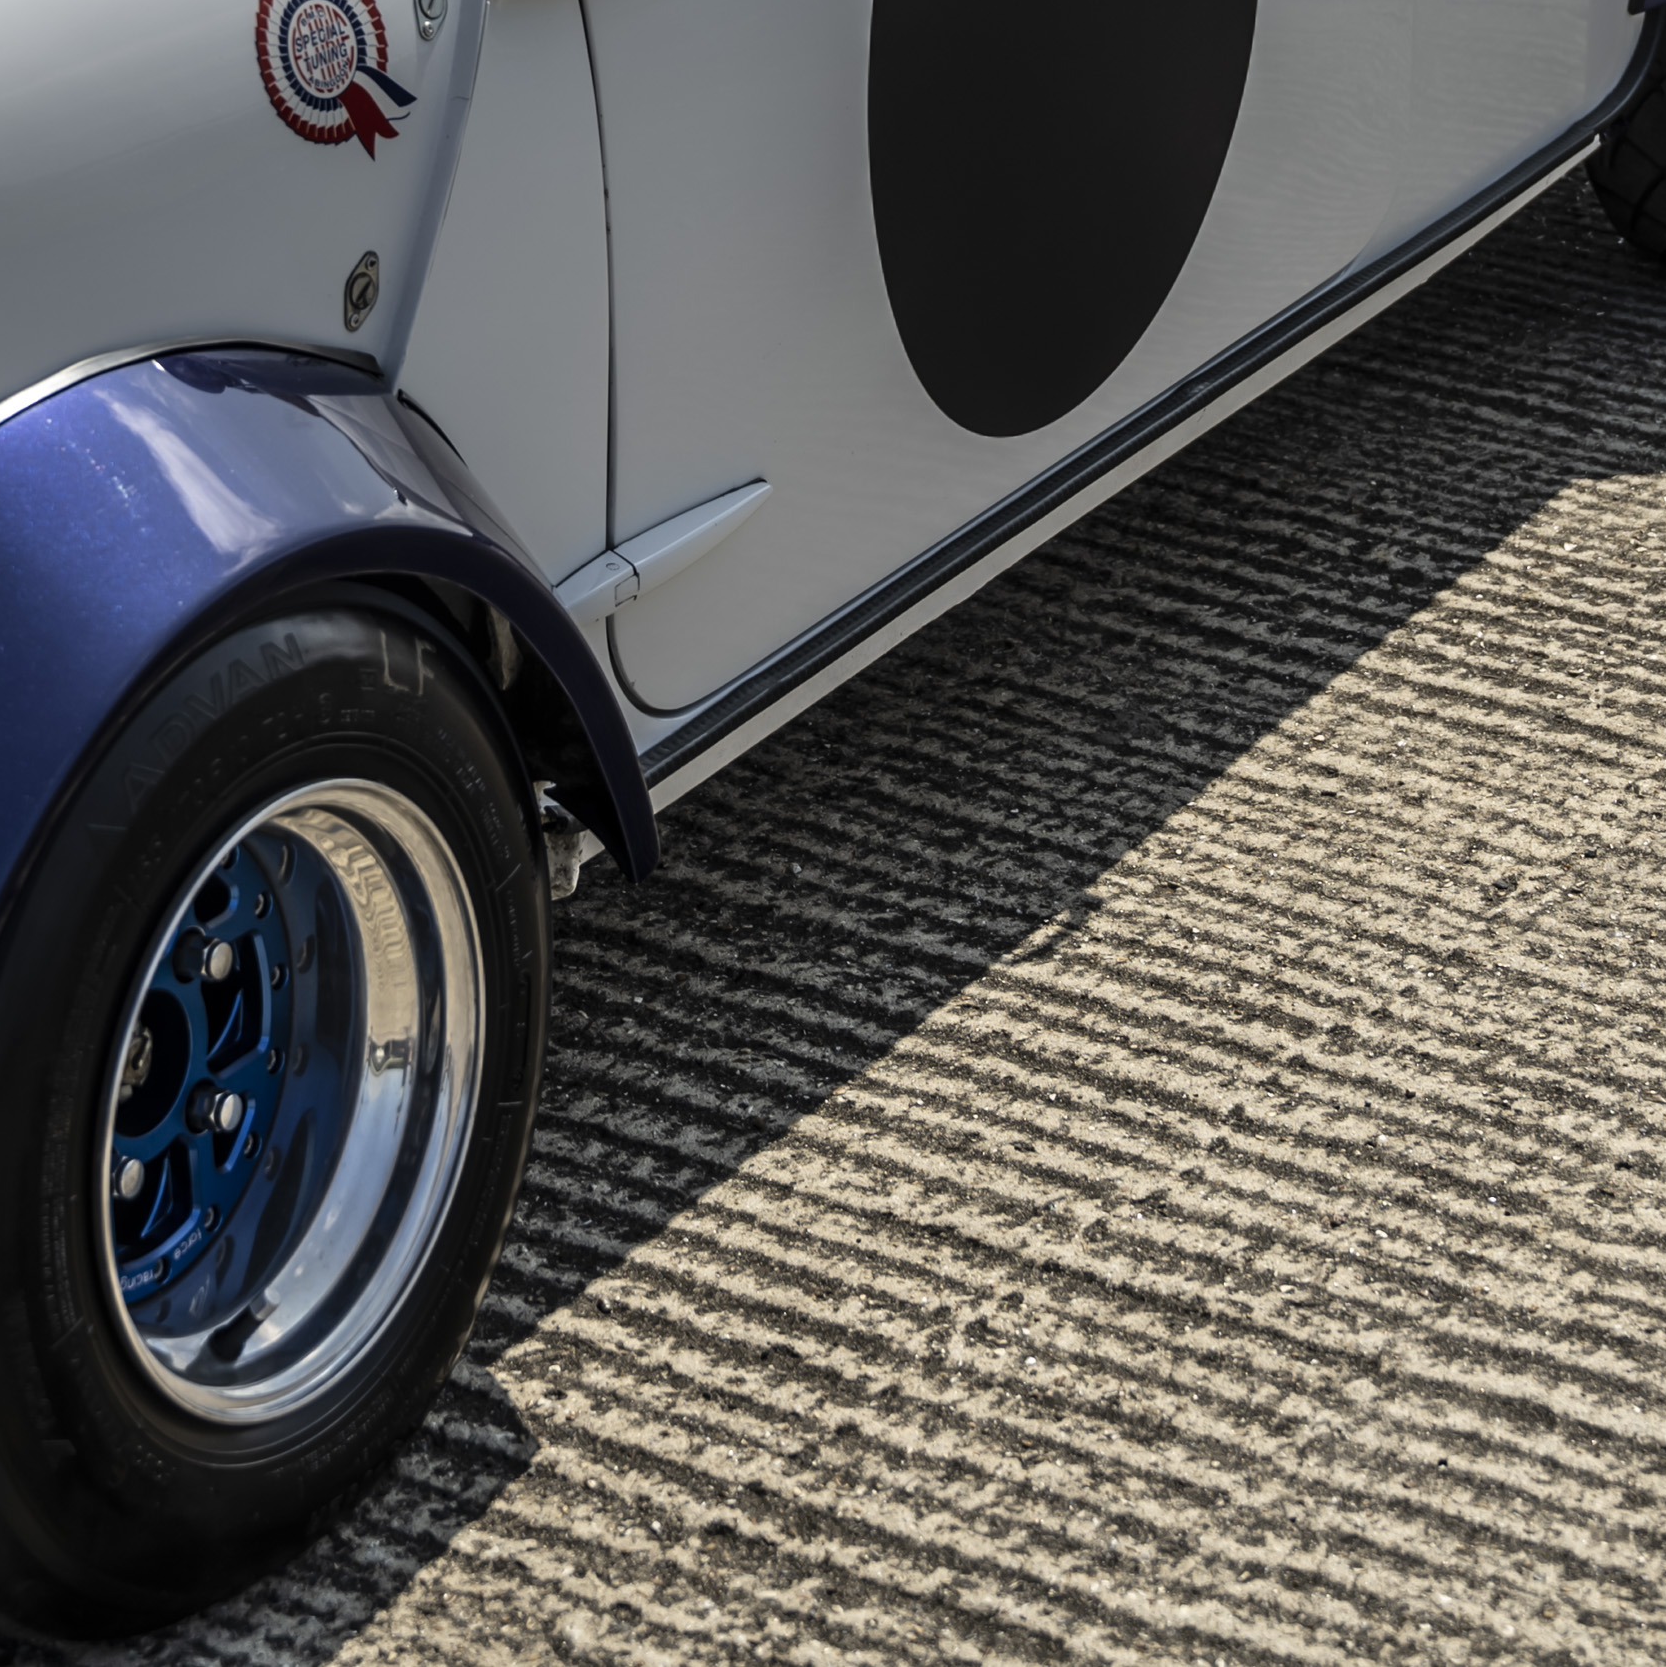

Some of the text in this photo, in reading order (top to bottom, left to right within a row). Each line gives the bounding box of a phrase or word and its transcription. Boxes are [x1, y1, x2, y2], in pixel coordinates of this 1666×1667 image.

[295, 22, 345, 53] SPECIAL
[303, 43, 348, 72] TUNING
[308, 58, 350, 88] ABINGDON
[124, 633, 306, 815] ADVAN
[172, 1227, 202, 1261] force
